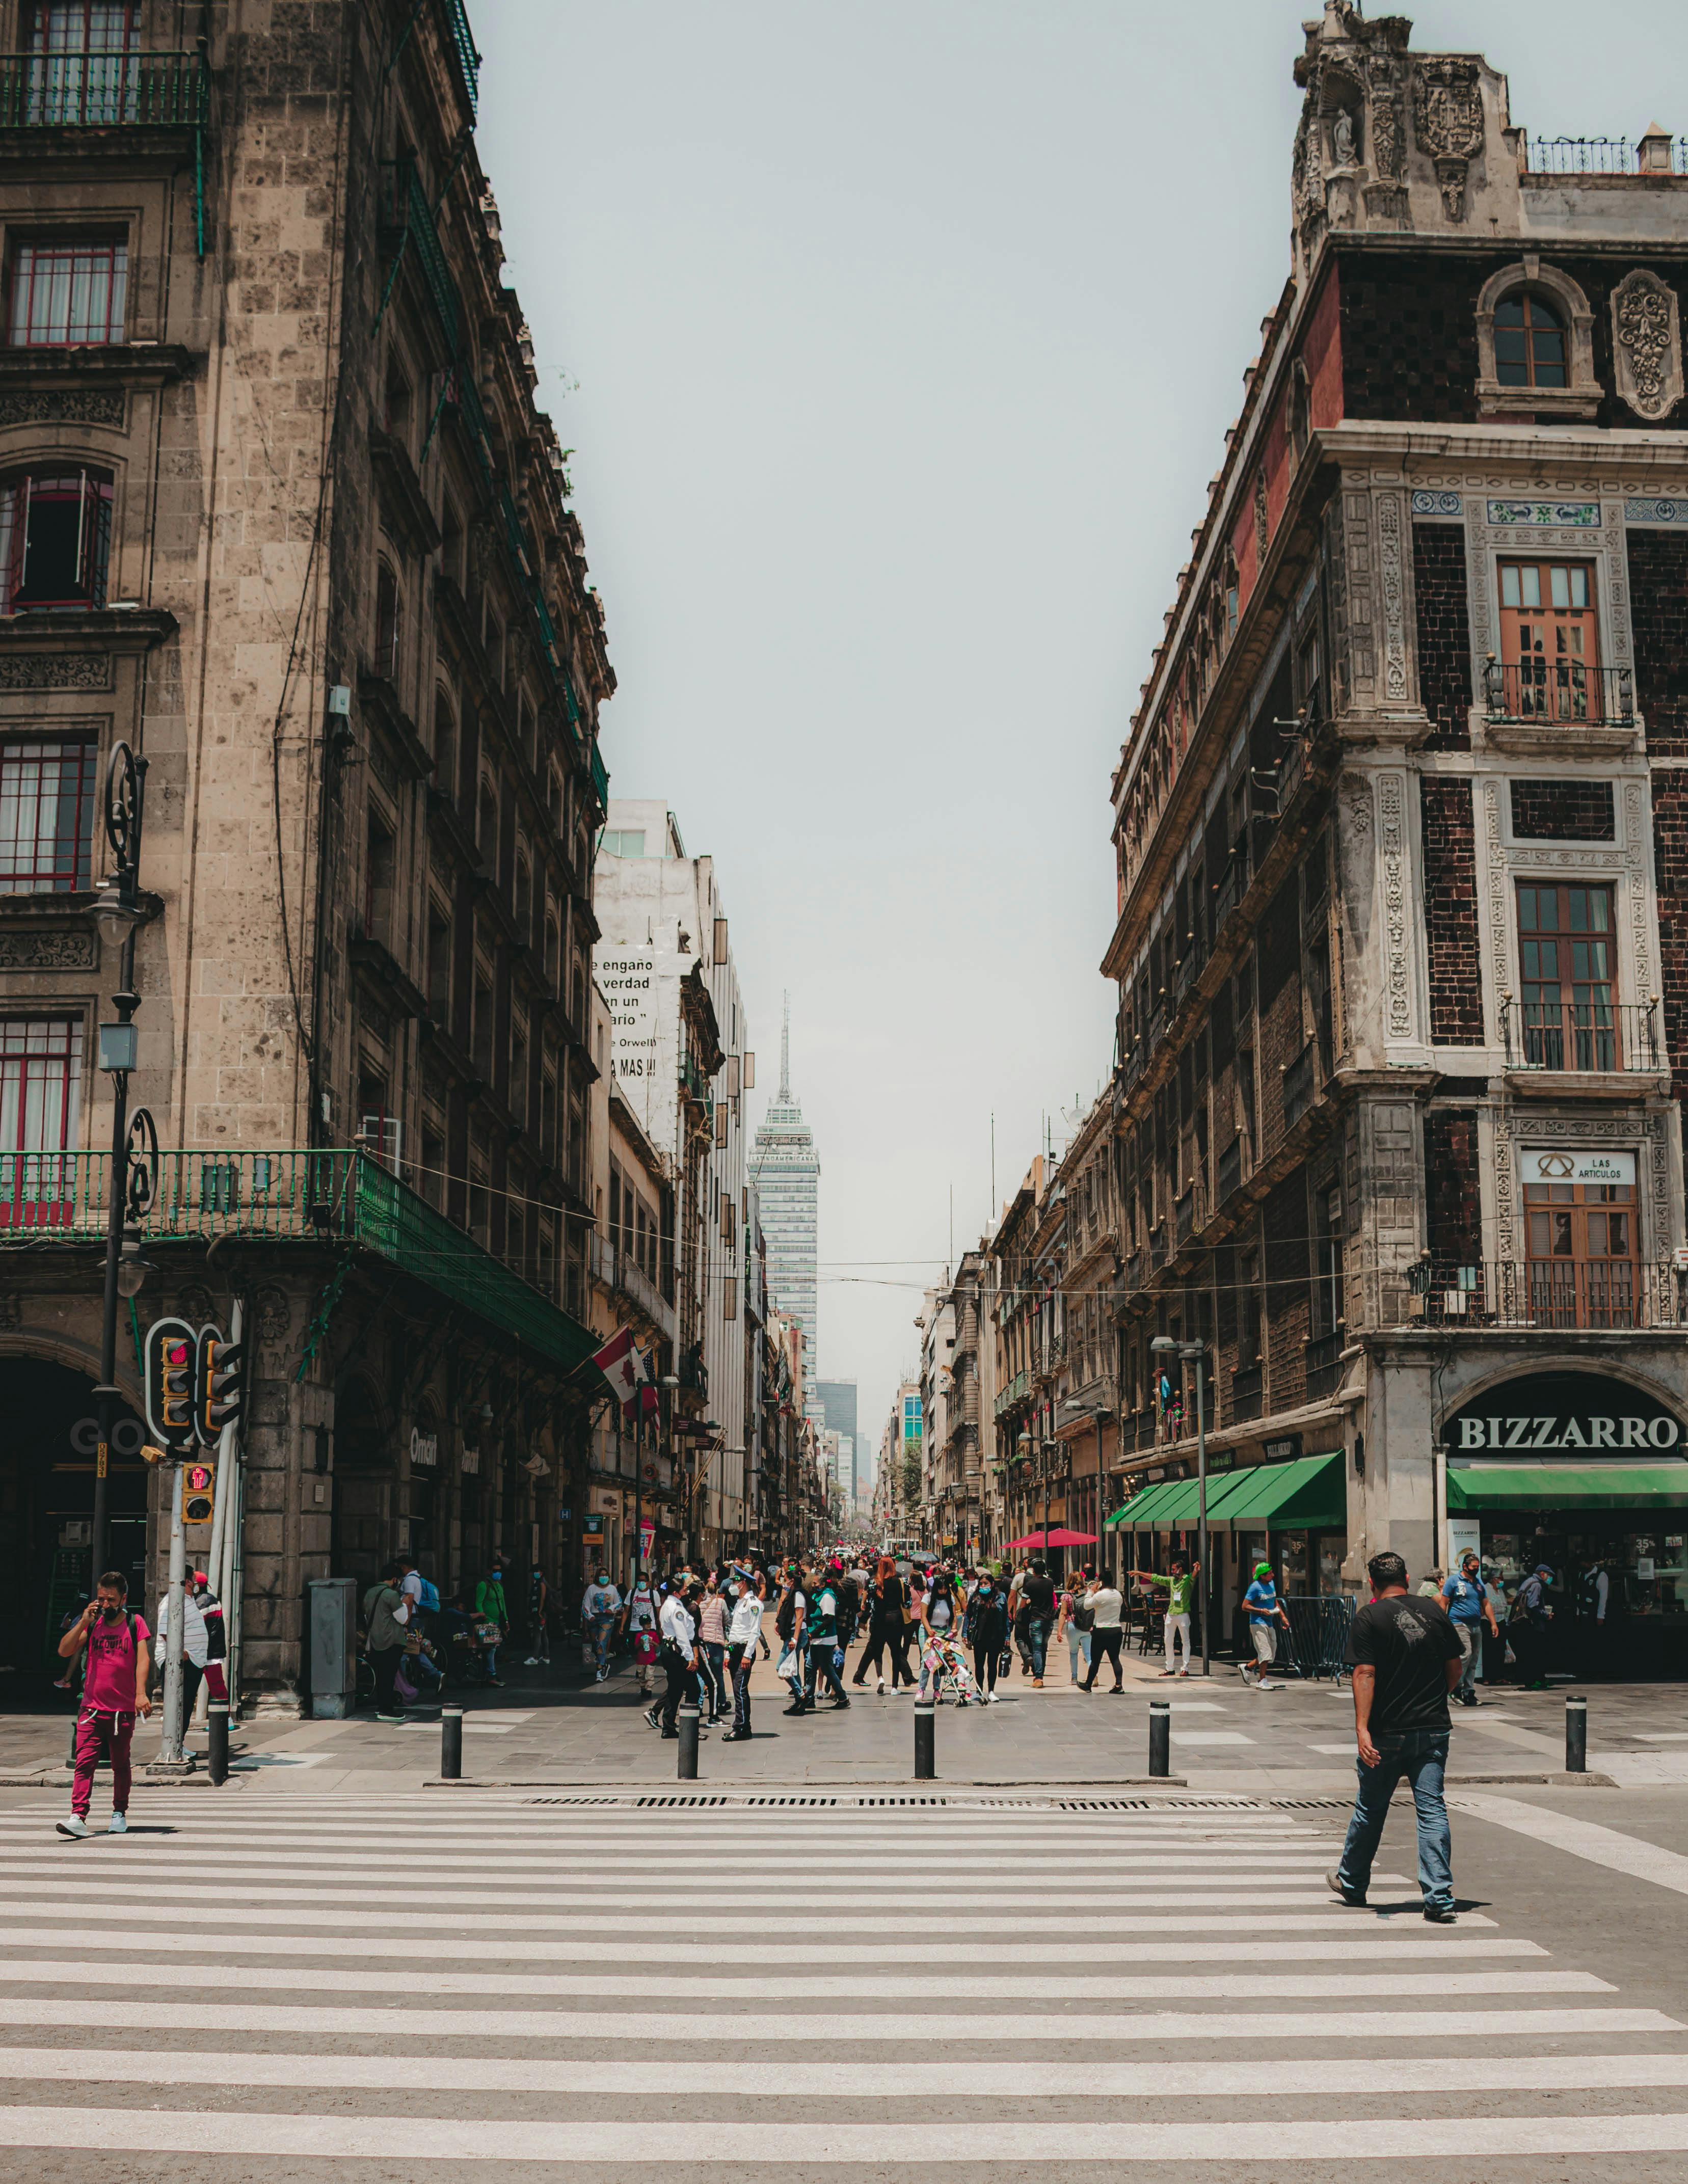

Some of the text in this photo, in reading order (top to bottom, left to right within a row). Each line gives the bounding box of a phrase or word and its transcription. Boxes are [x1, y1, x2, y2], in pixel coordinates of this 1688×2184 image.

[592, 959, 652, 974] e engaño
[603, 977, 650, 989] verdad
[623, 998, 639, 1007] un
[611, 1013, 635, 1025] ario
[611, 1059, 617, 1076] A
[620, 1059, 643, 1076] MAS
[1592, 1160, 1611, 1168] LAS
[1578, 1170, 1621, 1178] ARTICULOS
[70, 1417, 146, 1455] GO
[1458, 1416, 1678, 1449] BIZZARRO
